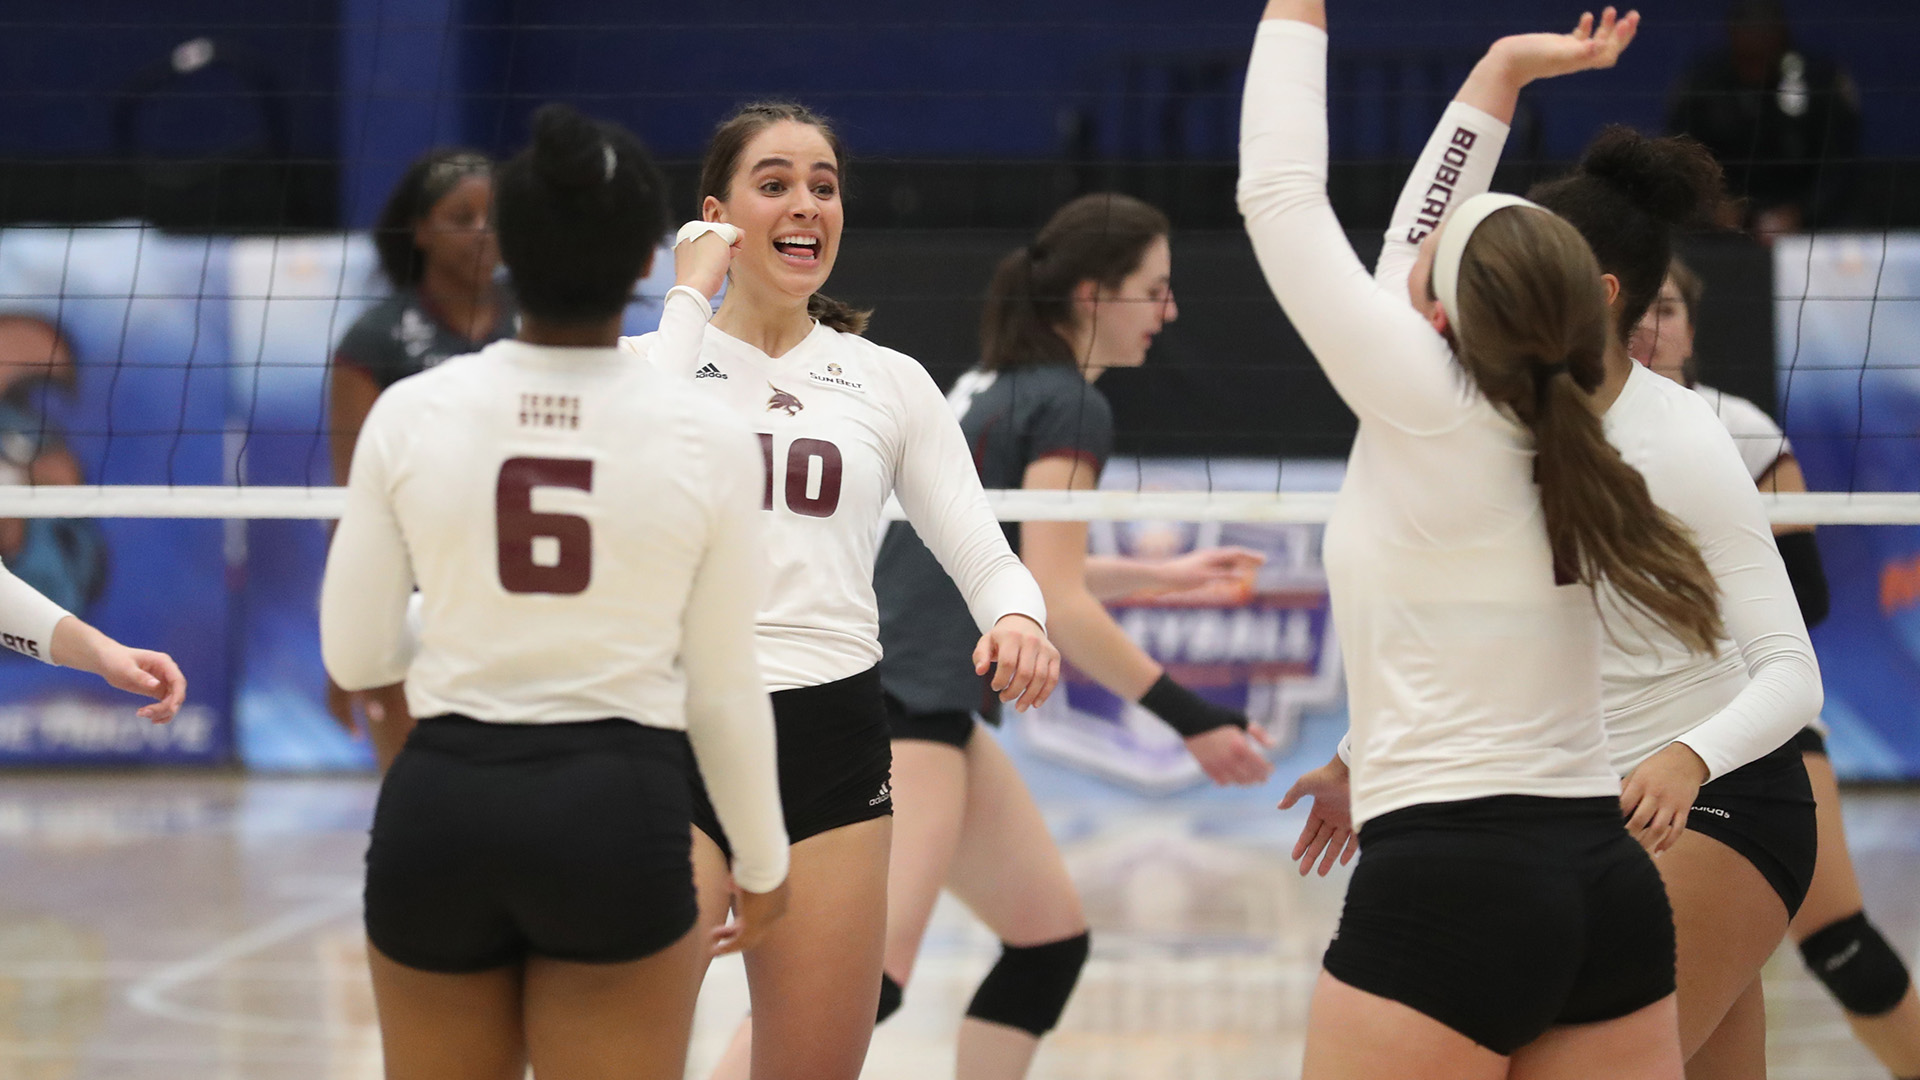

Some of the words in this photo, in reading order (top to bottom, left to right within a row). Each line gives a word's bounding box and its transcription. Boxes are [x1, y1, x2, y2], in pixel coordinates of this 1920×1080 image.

[1406, 127, 1478, 245] BOBCATS
[496, 456, 595, 596] 6
[754, 432, 843, 518] 10
